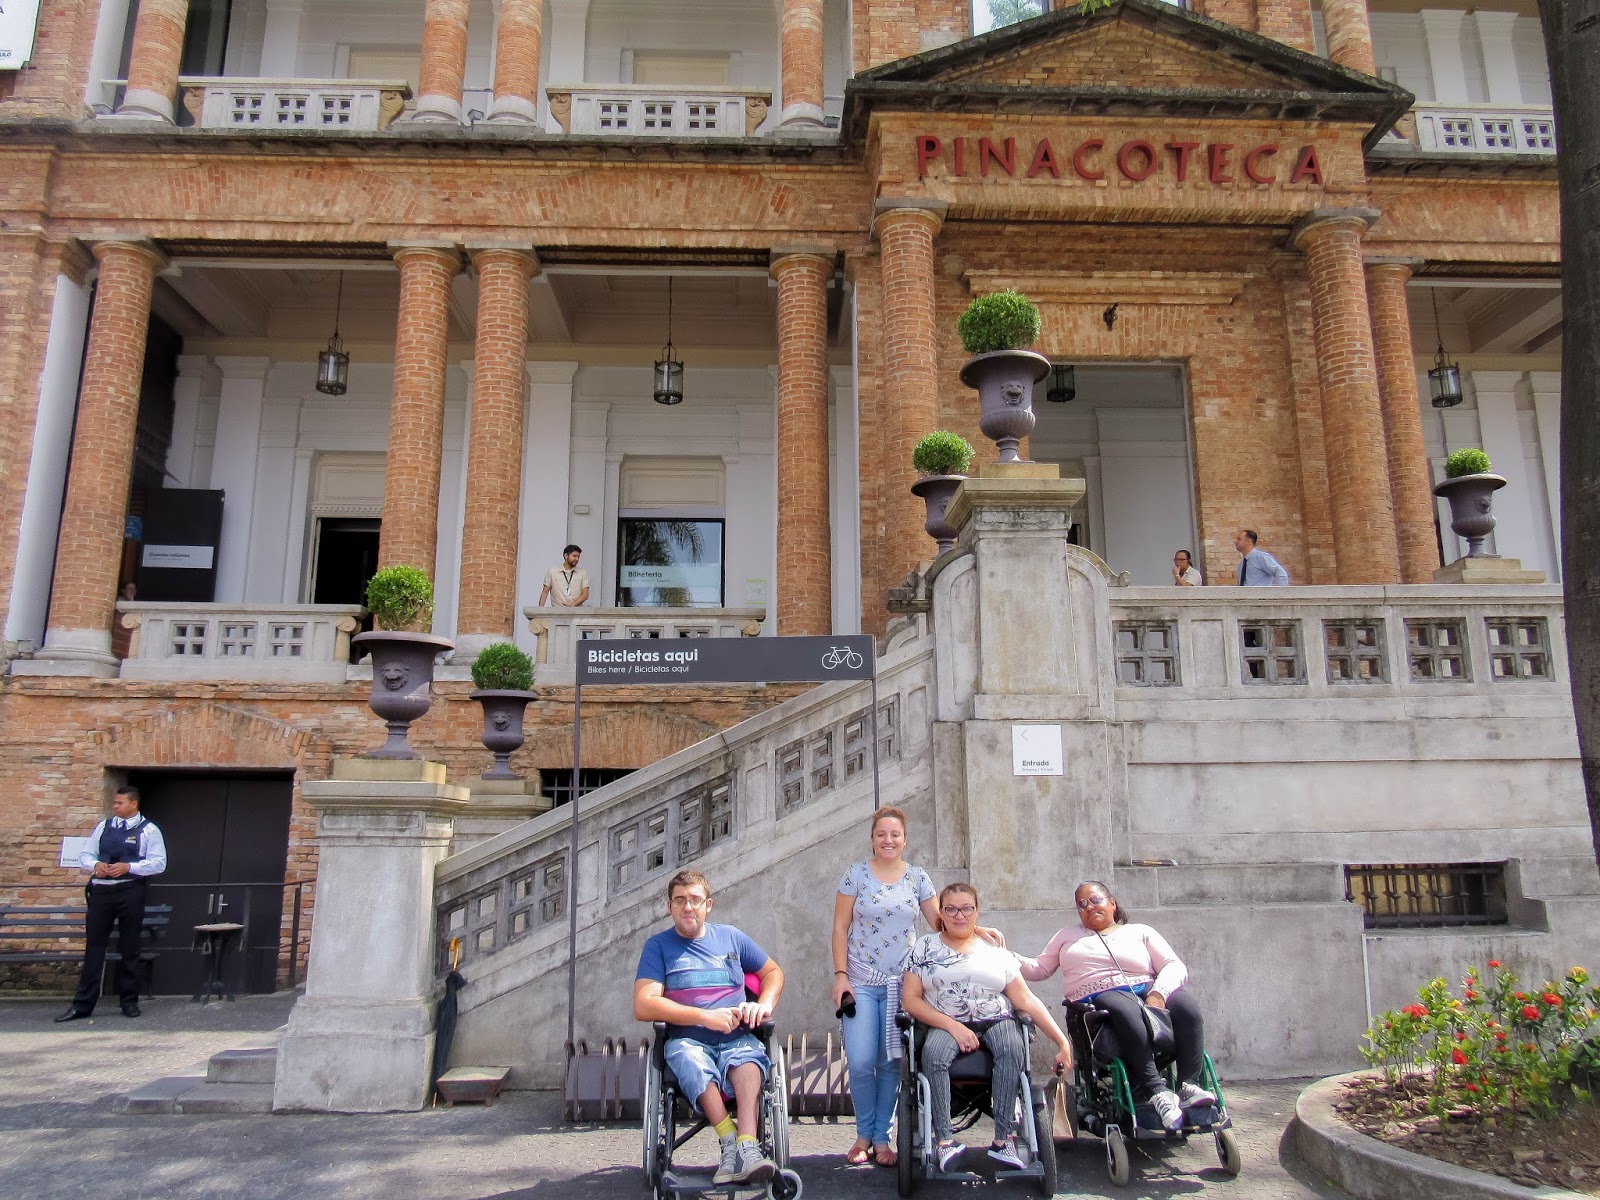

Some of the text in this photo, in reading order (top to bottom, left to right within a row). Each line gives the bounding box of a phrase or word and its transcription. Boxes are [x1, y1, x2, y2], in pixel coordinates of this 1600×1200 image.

[916, 135, 1323, 184] PINACOTECA
[588, 648, 698, 664] Bicicletas aqui
[587, 665, 607, 674] Bikes
[608, 665, 626, 673] here
[634, 665, 670, 673] Bicicletas
